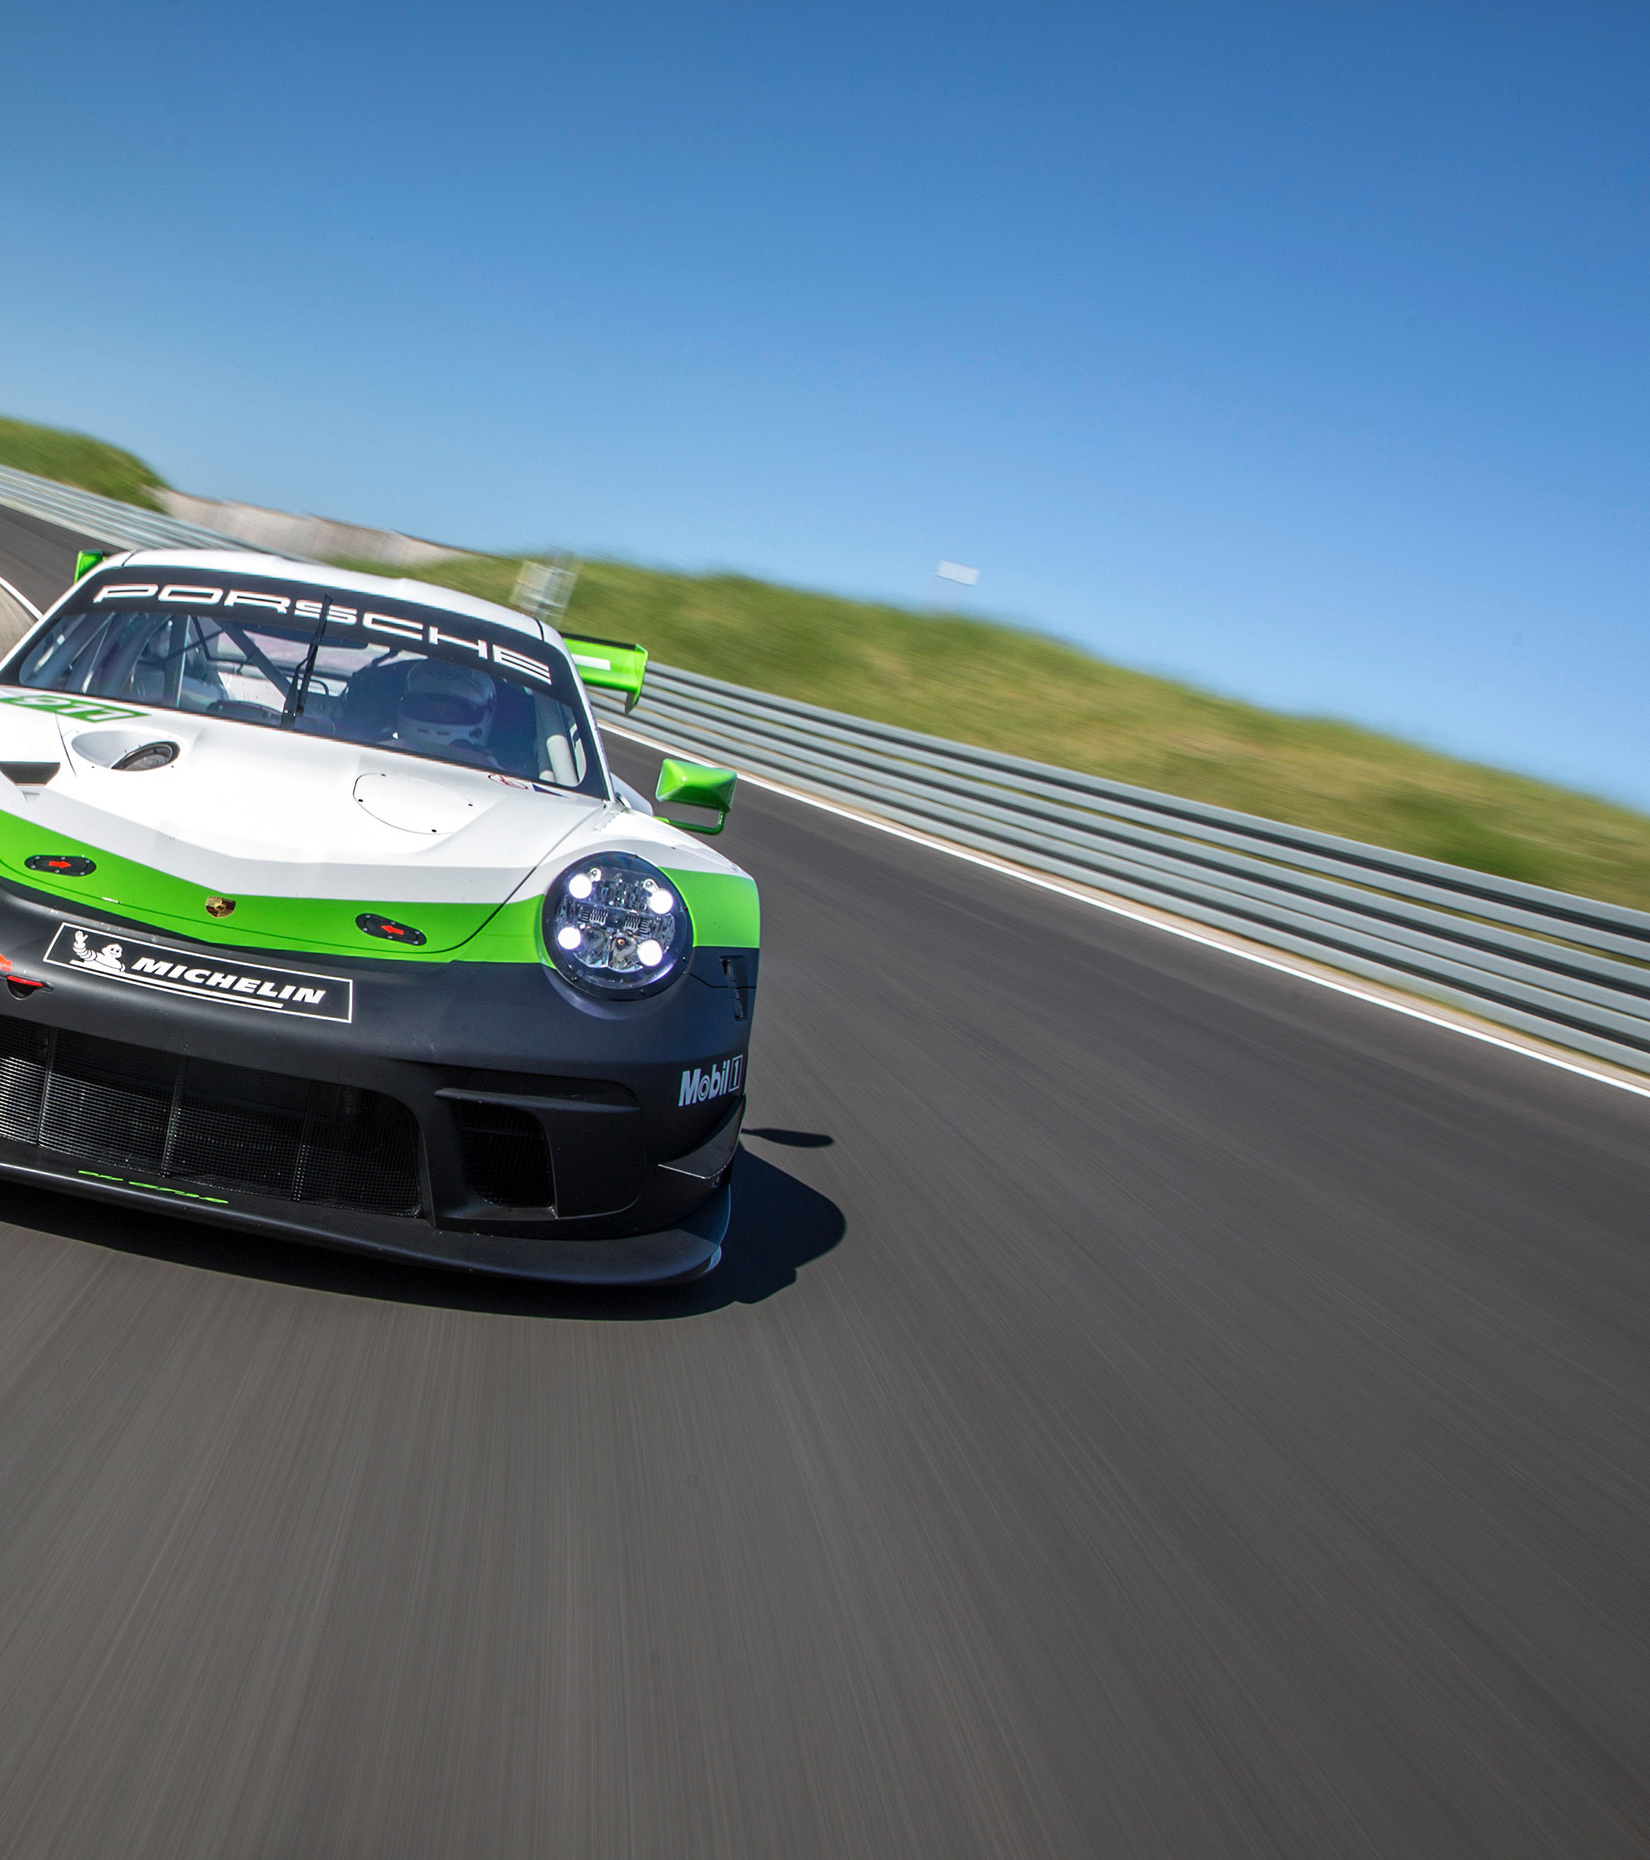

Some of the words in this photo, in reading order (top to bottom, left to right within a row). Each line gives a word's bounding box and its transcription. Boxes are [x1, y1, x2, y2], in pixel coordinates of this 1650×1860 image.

[93, 583, 552, 686] PORSCHE
[10, 696, 136, 721] 911
[131, 955, 327, 1004] MICHELIN
[677, 1059, 731, 1107] Mobil
